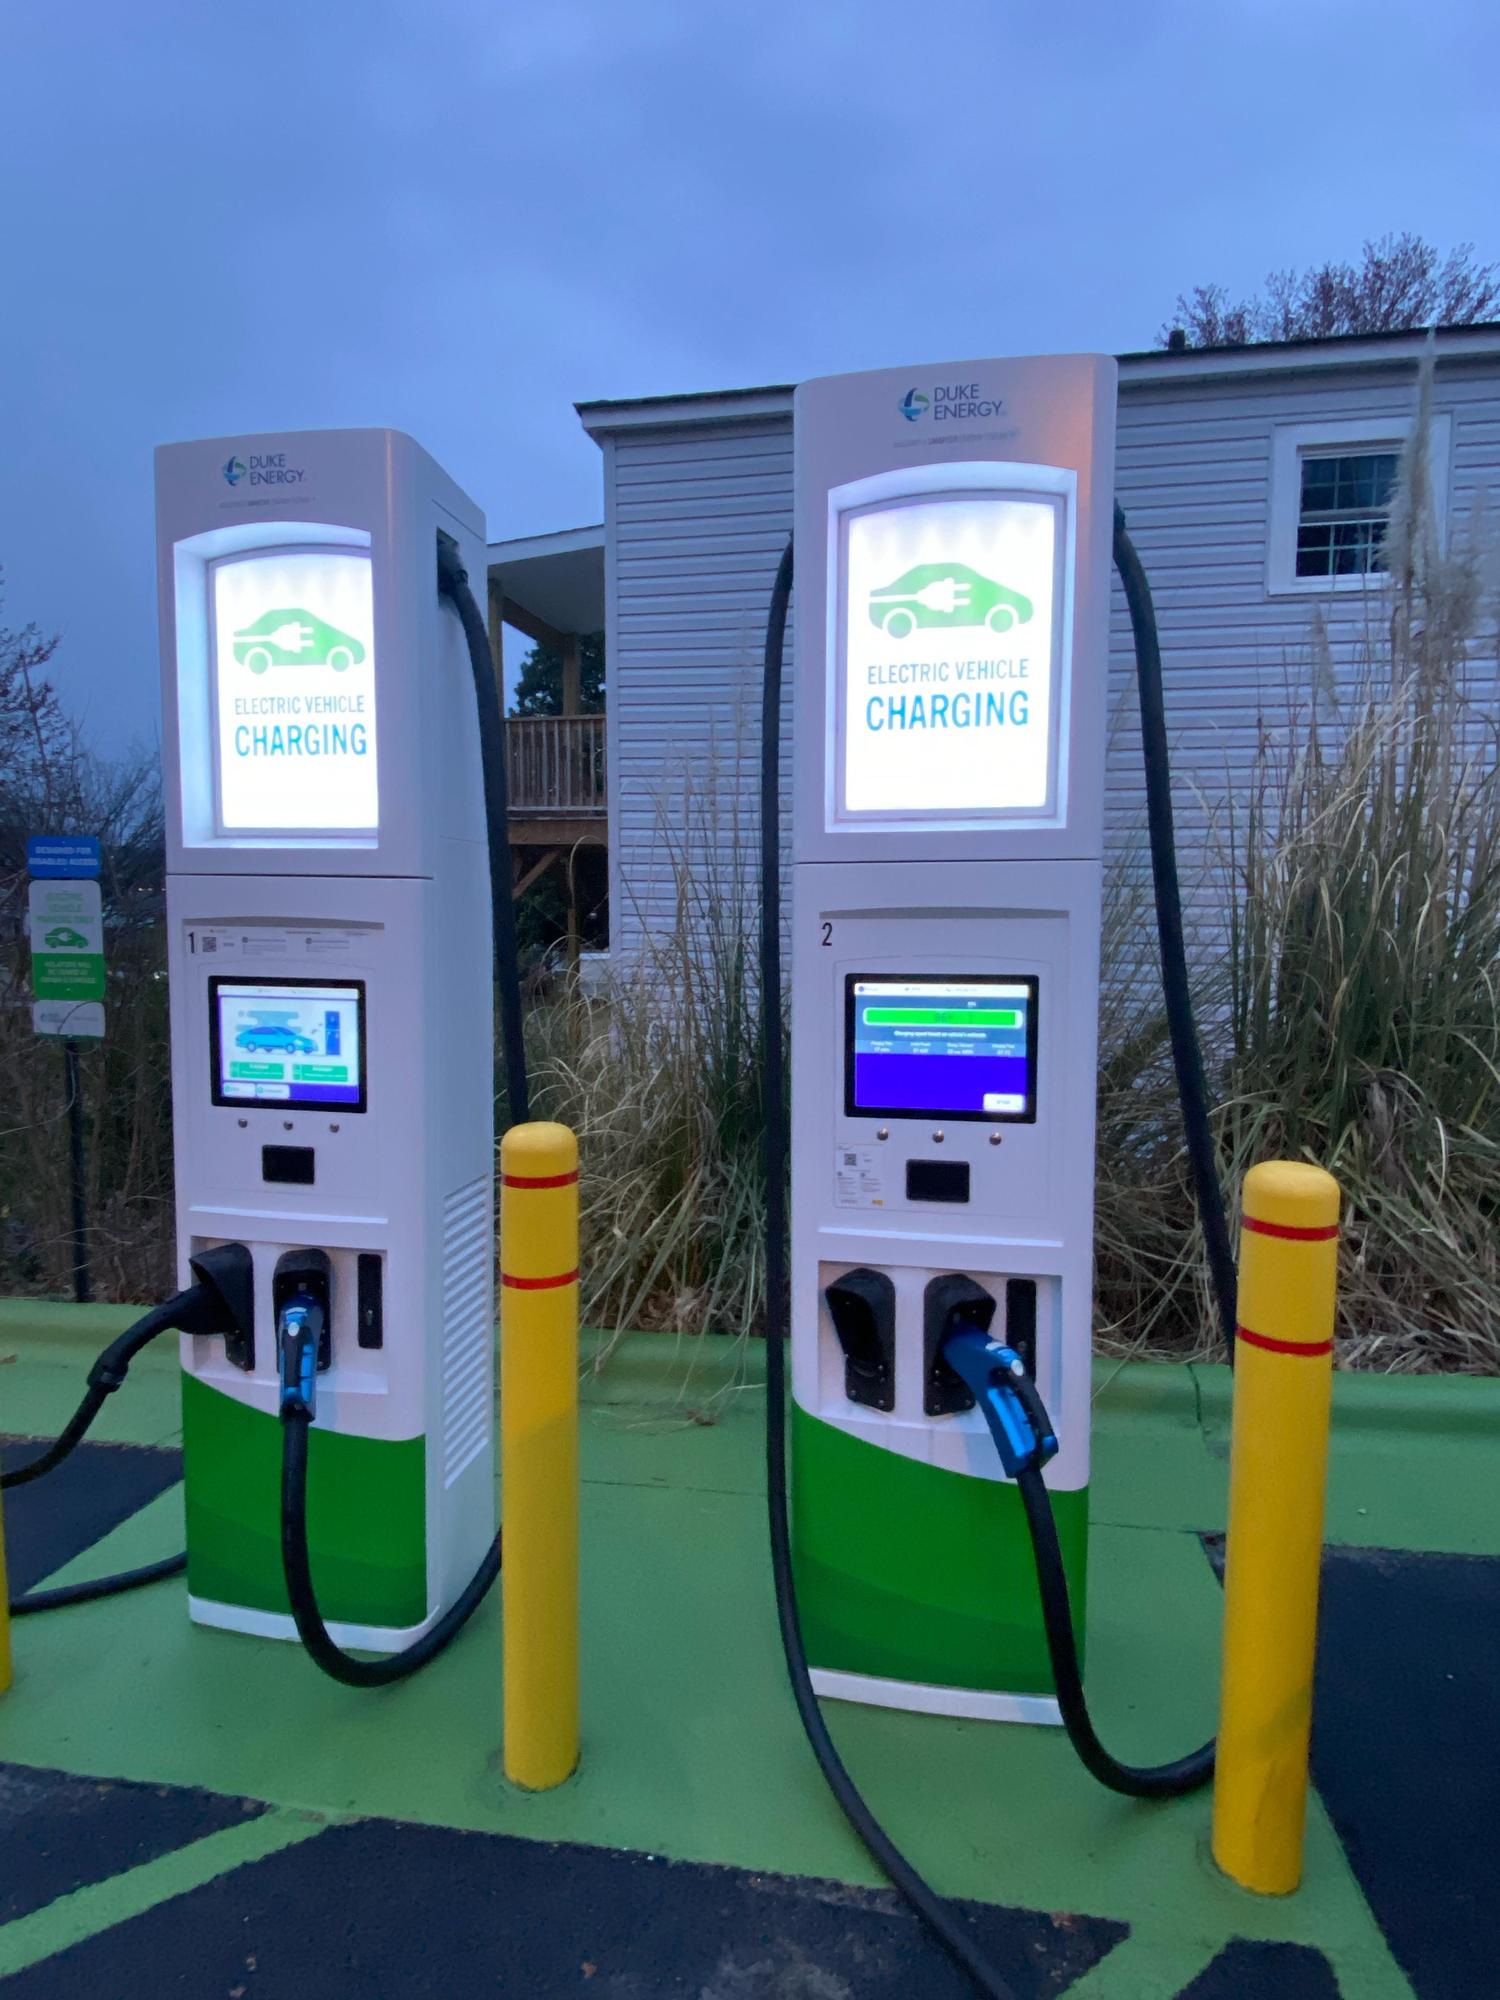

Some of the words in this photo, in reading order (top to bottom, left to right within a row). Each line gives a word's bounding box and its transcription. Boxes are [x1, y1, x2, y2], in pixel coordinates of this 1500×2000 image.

[934, 383, 979, 402] DUKE
[933, 401, 1002, 421] ENERGY
[249, 453, 286, 468] DUKE
[250, 469, 304, 486] ENERGY
[867, 663, 949, 685] ELECTRIC
[954, 658, 1029, 681] VEHICLE
[234, 696, 301, 716] ELECTRIC
[305, 695, 365, 713] VEHICLE
[865, 690, 1029, 731] CHARGING
[234, 723, 367, 757] CHARGING
[187, 931, 195, 954] 1
[821, 922, 833, 947] 2
